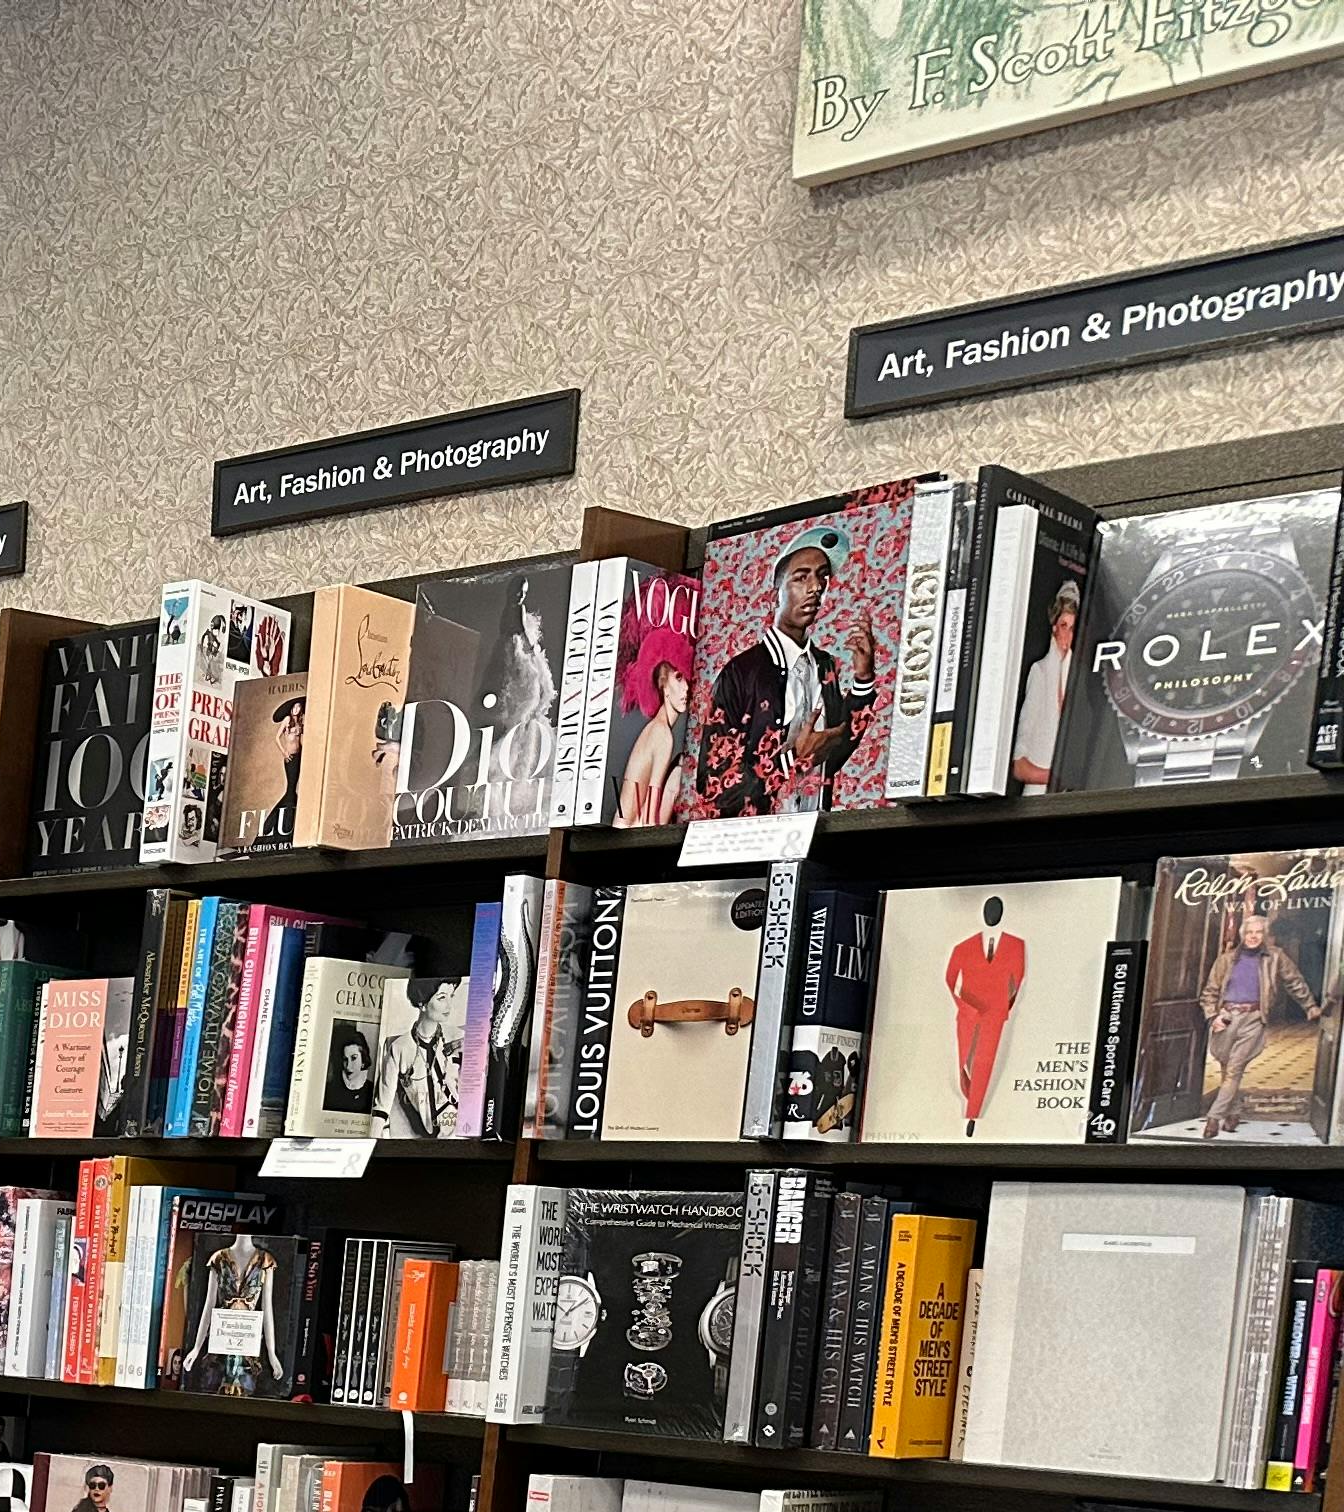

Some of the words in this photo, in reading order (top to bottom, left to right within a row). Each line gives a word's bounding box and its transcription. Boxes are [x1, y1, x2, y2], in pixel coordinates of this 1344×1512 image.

[808, 74, 890, 141] By
[908, 47, 951, 111] F.
[968, 9, 1113, 94] Scott
[877, 353, 934, 382] Art,
[944, 324, 1070, 370] Fashion
[1083, 314, 1111, 342] &
[1121, 267, 1344, 336] Photography
[232, 473, 272, 506] Art,
[279, 465, 363, 499] Fashion
[372, 456, 393, 481] &
[399, 425, 550, 483] Photography
[597, 597, 618, 671] VOGUE
[1092, 620, 1322, 672] ROLEX
[1153, 674, 1253, 691] PHILOSOPHY
[583, 702, 610, 780] MUSIC
[1174, 867, 1254, 907] Ralph
[764, 870, 793, 970] G-SHOCK
[248, 926, 260, 956] BILL
[803, 905, 828, 1017] WHIZLIMITED
[53, 991, 102, 1008] MISS
[233, 958, 258, 1050] CUNNINGHAM
[49, 1010, 102, 1030] DIOR
[572, 1043, 606, 1136] LOUIS
[589, 891, 621, 1036] VUITTON
[1054, 1040, 1091, 1058] THE
[1035, 1058, 1089, 1075] MEN'S
[1013, 1077, 1088, 1095] FASHION
[1035, 1095, 1086, 1112] BOOK
[180, 1200, 278, 1225] COSPLAY
[775, 1175, 804, 1246] BANGER
[743, 1180, 773, 1279] G-SHOCK
[938, 1282, 947, 1301] A
[920, 1299, 959, 1321] DECADE
[930, 1319, 949, 1339] OF
[919, 1339, 952, 1359] MEN'S
[913, 1356, 954, 1378] STREET
[914, 1376, 948, 1398] STYLE
